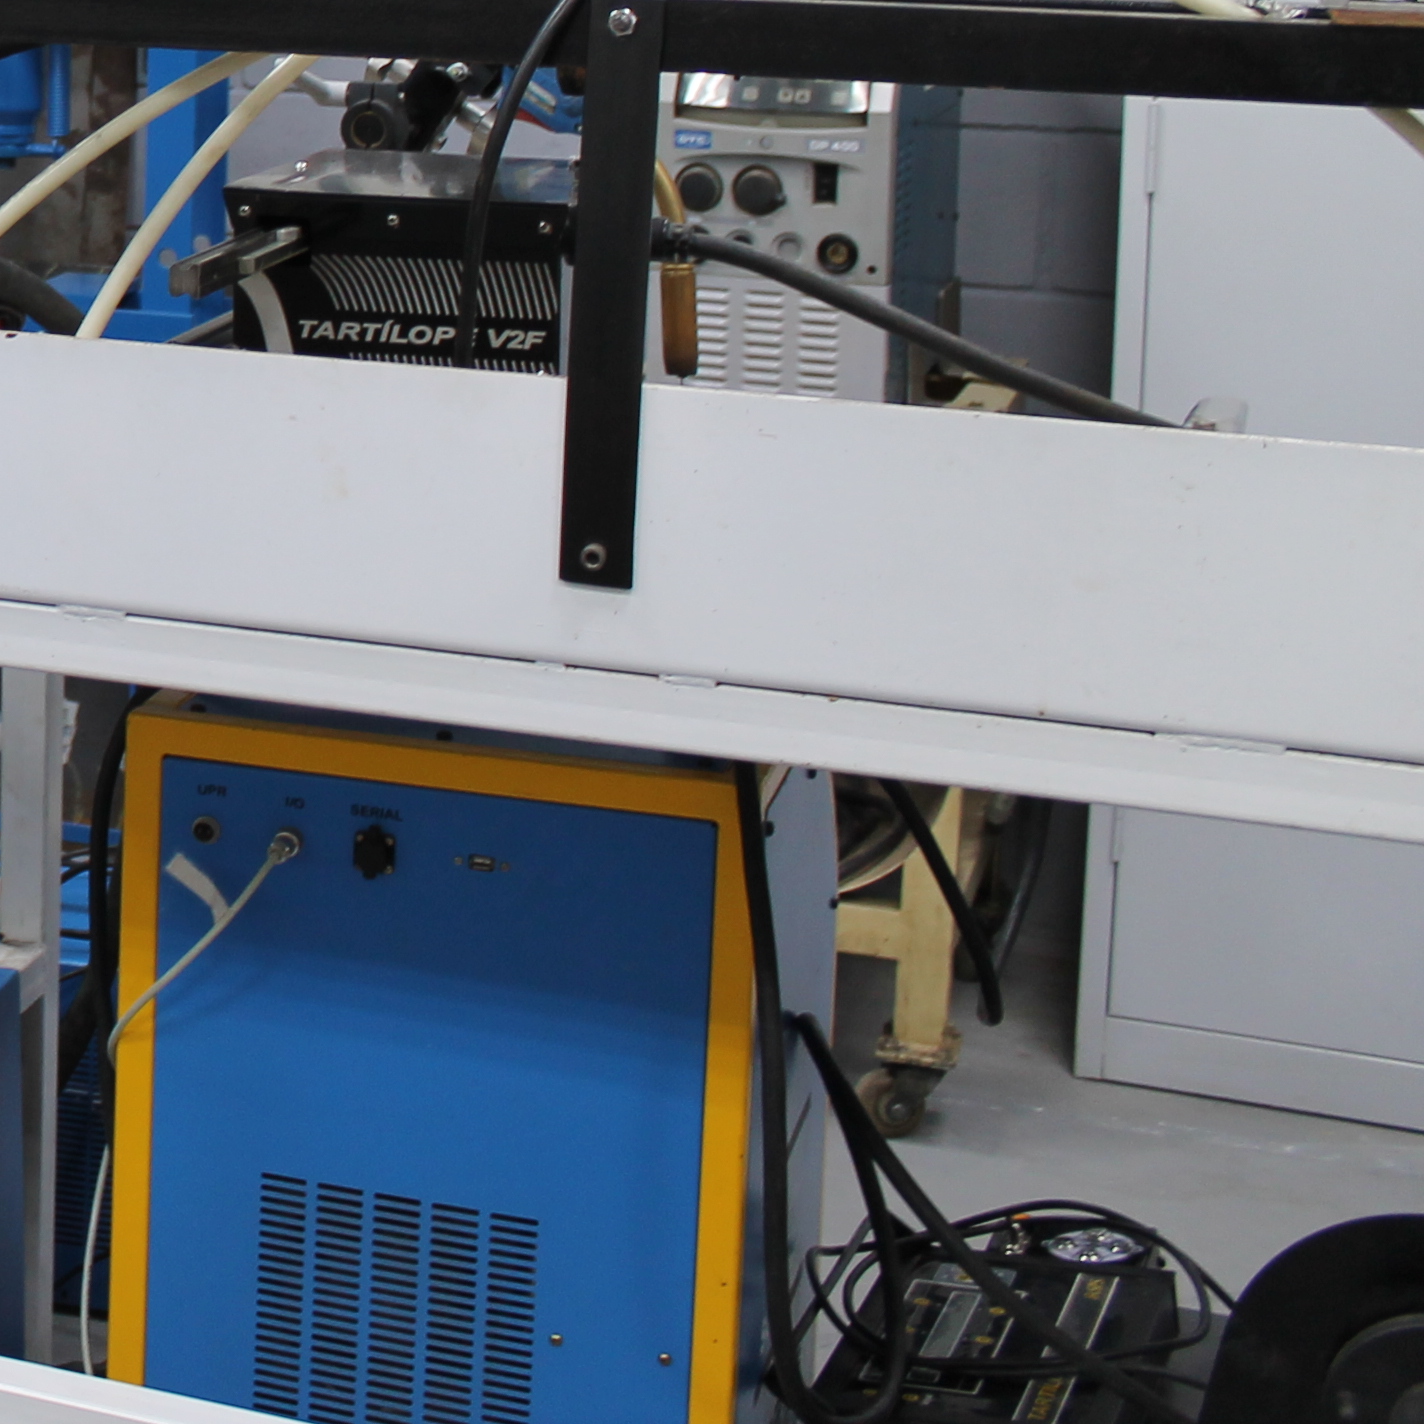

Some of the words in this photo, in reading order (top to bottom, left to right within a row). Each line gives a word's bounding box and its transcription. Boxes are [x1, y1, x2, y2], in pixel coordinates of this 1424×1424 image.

[298, 319, 479, 349] TARTÍLOP
[487, 328, 547, 350] V2F
[350, 803, 403, 822] SERIAL
